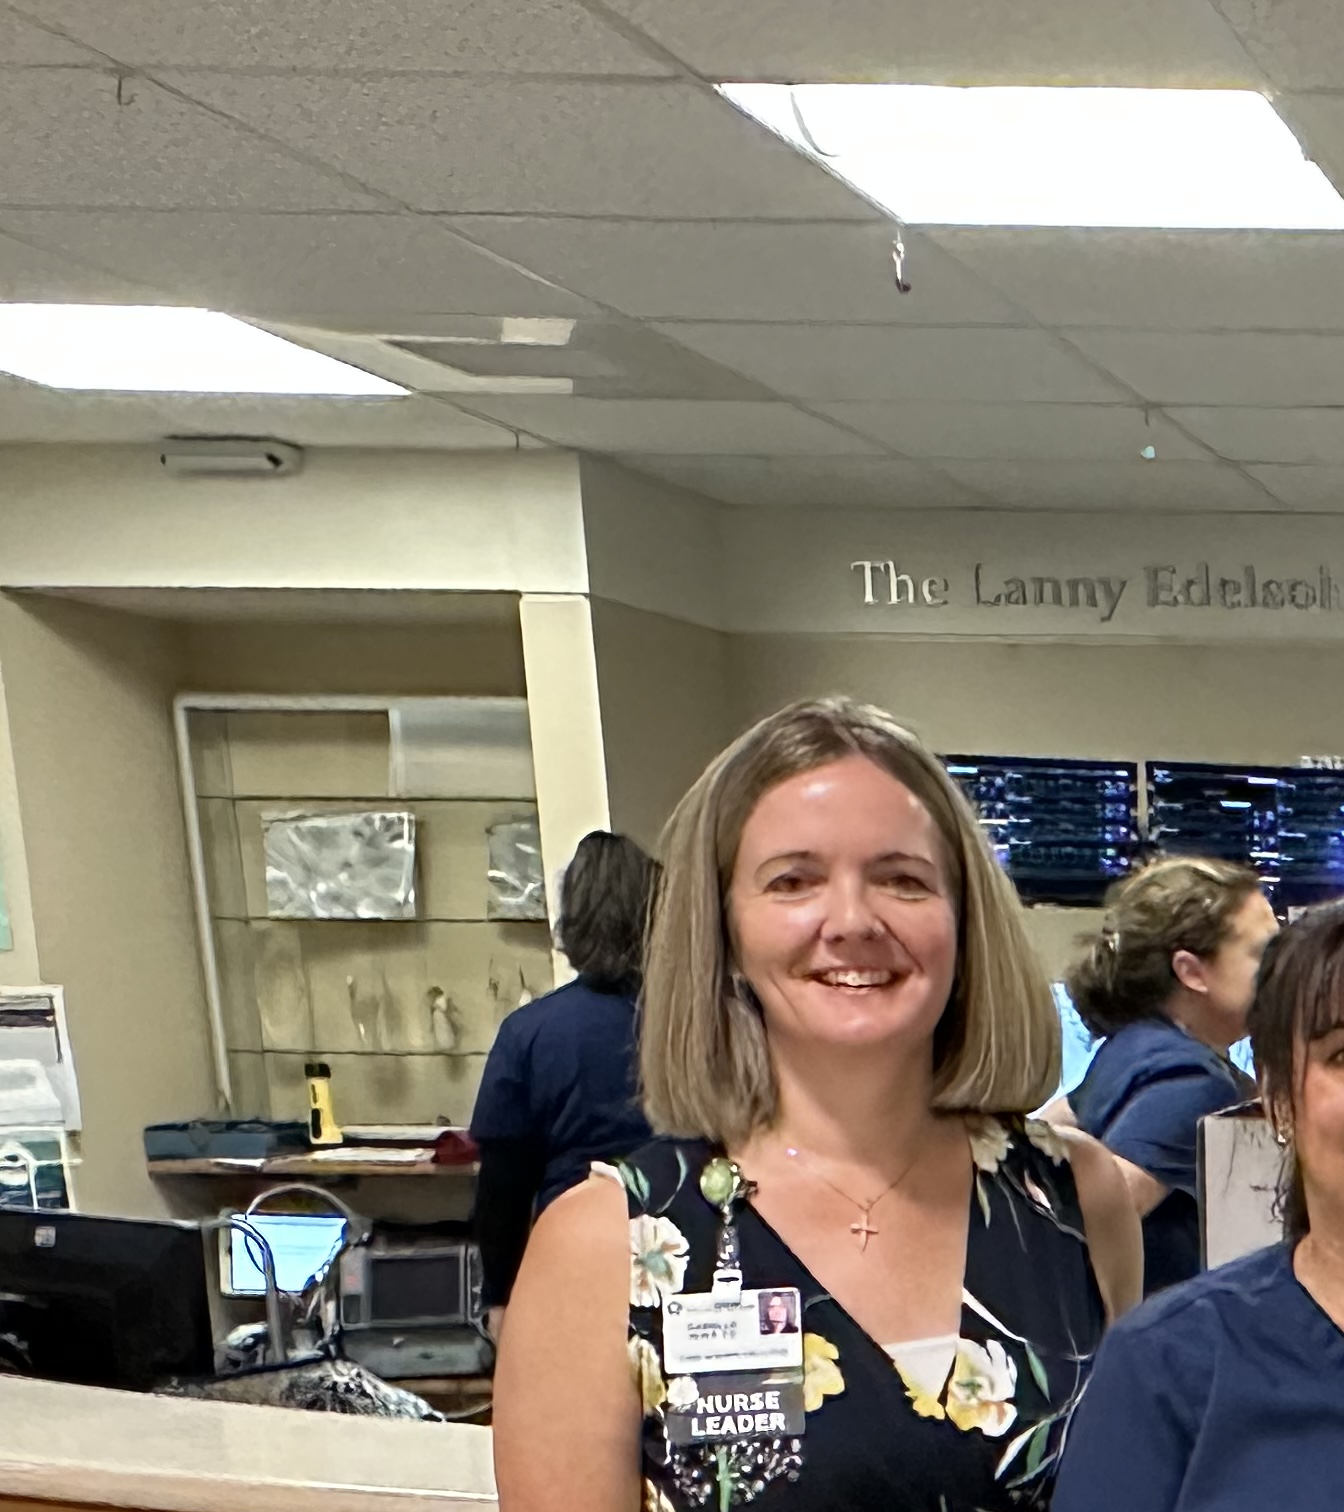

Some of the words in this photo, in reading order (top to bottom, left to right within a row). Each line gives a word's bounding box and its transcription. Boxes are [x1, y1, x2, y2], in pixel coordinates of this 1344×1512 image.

[848, 558, 950, 608] The
[974, 560, 1127, 624] Lanny
[697, 1390, 781, 1414] NURSE
[691, 1412, 786, 1436] LEADER
